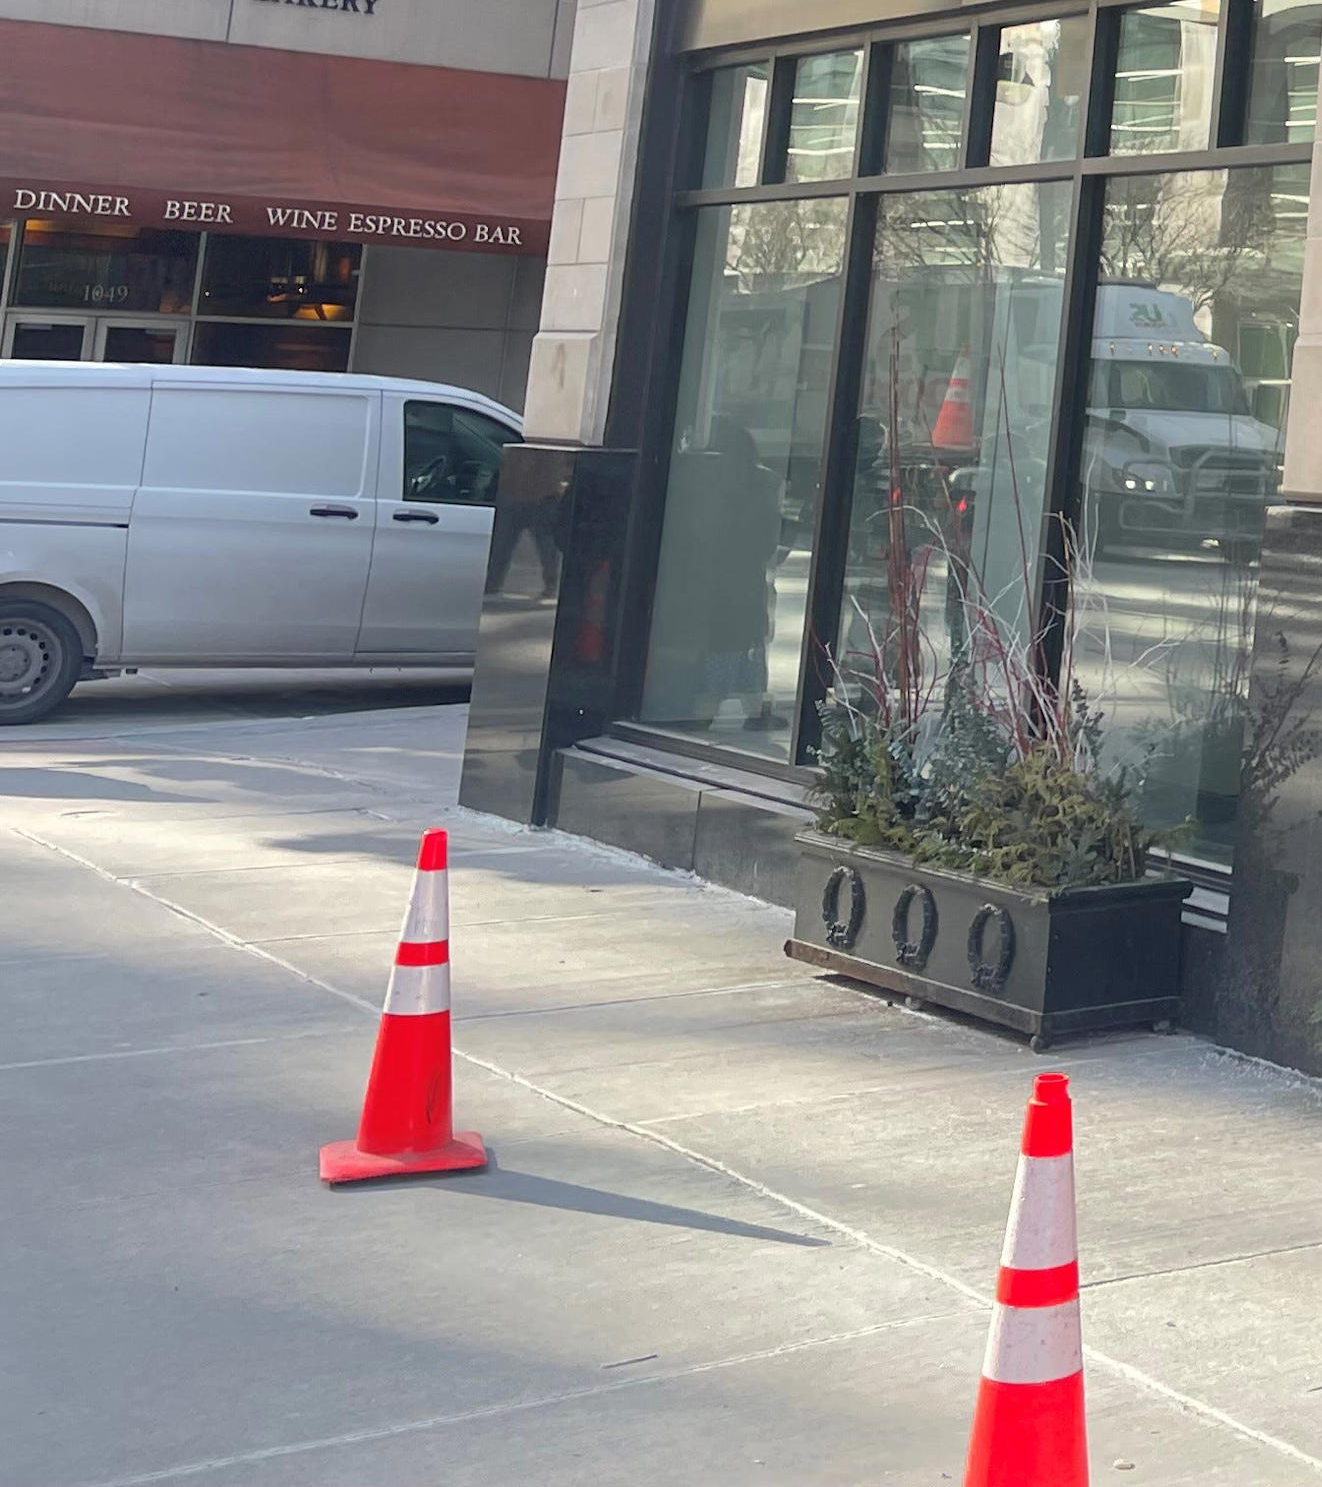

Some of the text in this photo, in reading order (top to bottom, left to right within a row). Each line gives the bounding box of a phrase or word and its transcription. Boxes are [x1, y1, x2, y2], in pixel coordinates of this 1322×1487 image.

[13, 189, 522, 245] DINNER BEER WINE ESPRESSO BAR
[83, 284, 129, 303] 1049
